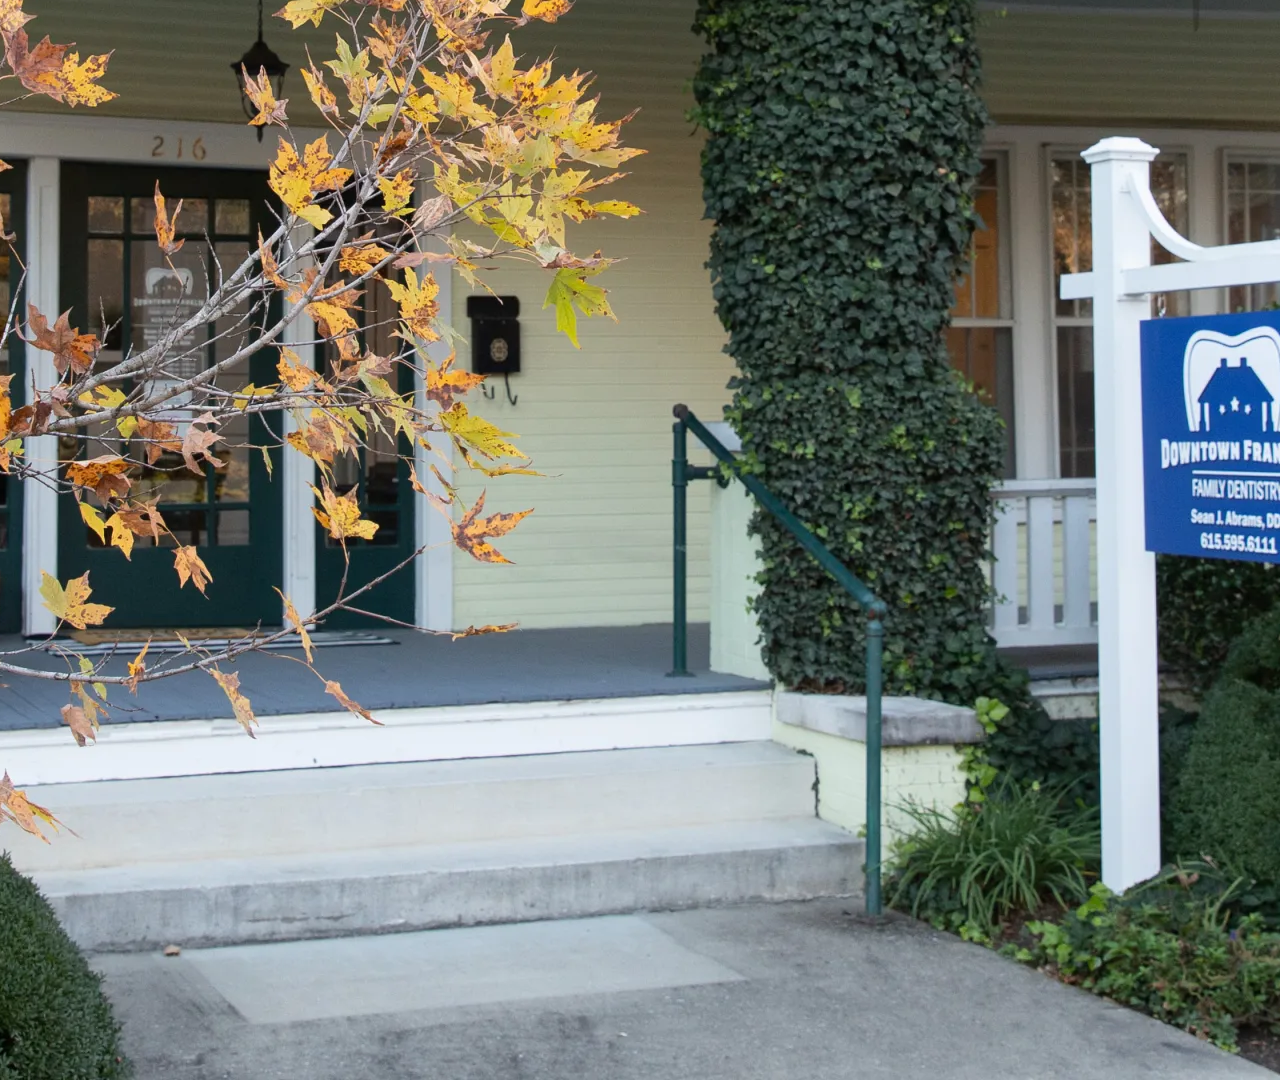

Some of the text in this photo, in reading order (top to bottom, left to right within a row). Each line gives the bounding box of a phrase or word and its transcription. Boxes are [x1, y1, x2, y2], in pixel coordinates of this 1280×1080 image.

[152, 135, 207, 161] 216
[1160, 438, 1240, 469] DOWNTOWN
[1191, 478, 1226, 498] FAMILY
[1190, 508, 1215, 524] Sean
[1216, 510, 1224, 525] J.
[1225, 510, 1266, 531] Abrams,
[1200, 532, 1278, 554] 615.595.6111
